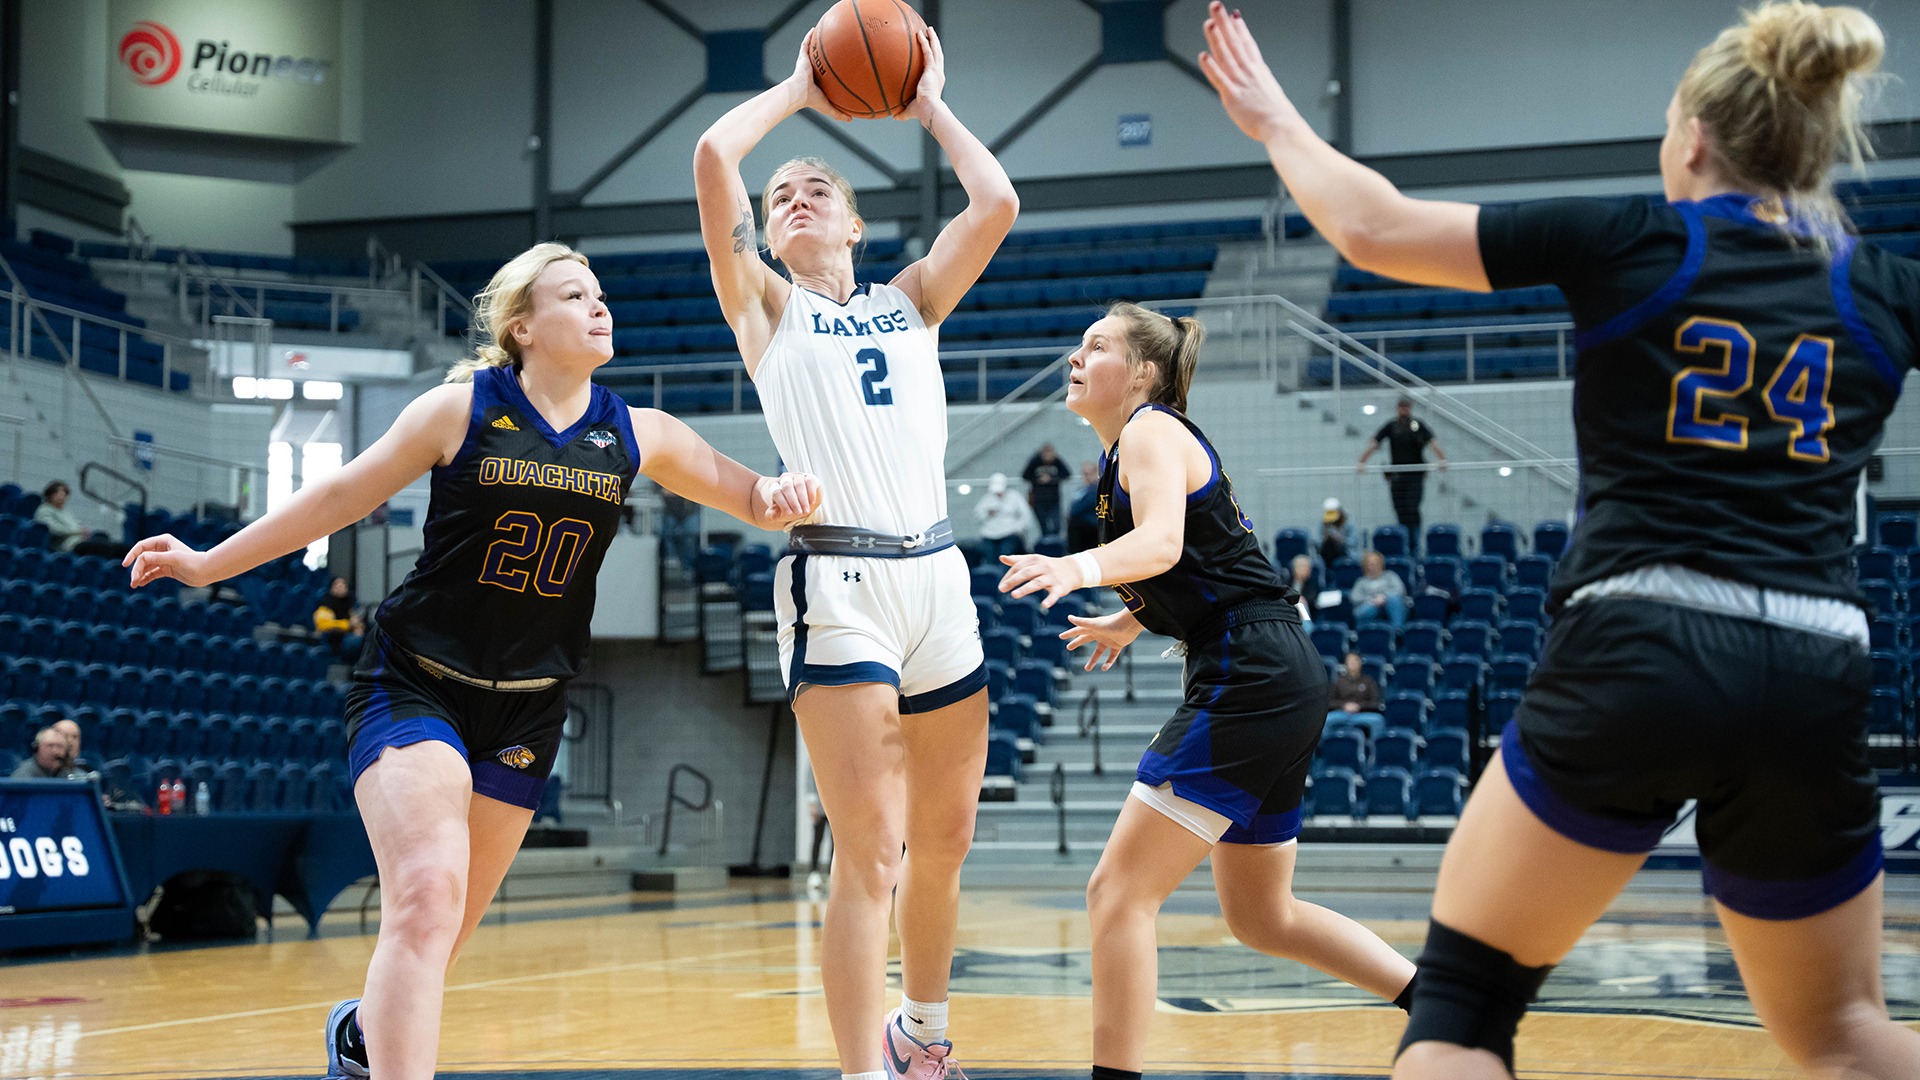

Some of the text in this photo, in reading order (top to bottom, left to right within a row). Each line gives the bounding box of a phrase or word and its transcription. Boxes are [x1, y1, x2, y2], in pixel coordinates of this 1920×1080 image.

[193, 39, 332, 84] Pioneer
[856, 348, 893, 405] 2
[1666, 316, 1835, 463] 24
[479, 457, 621, 505] OUACHITA
[478, 510, 594, 597] 20
